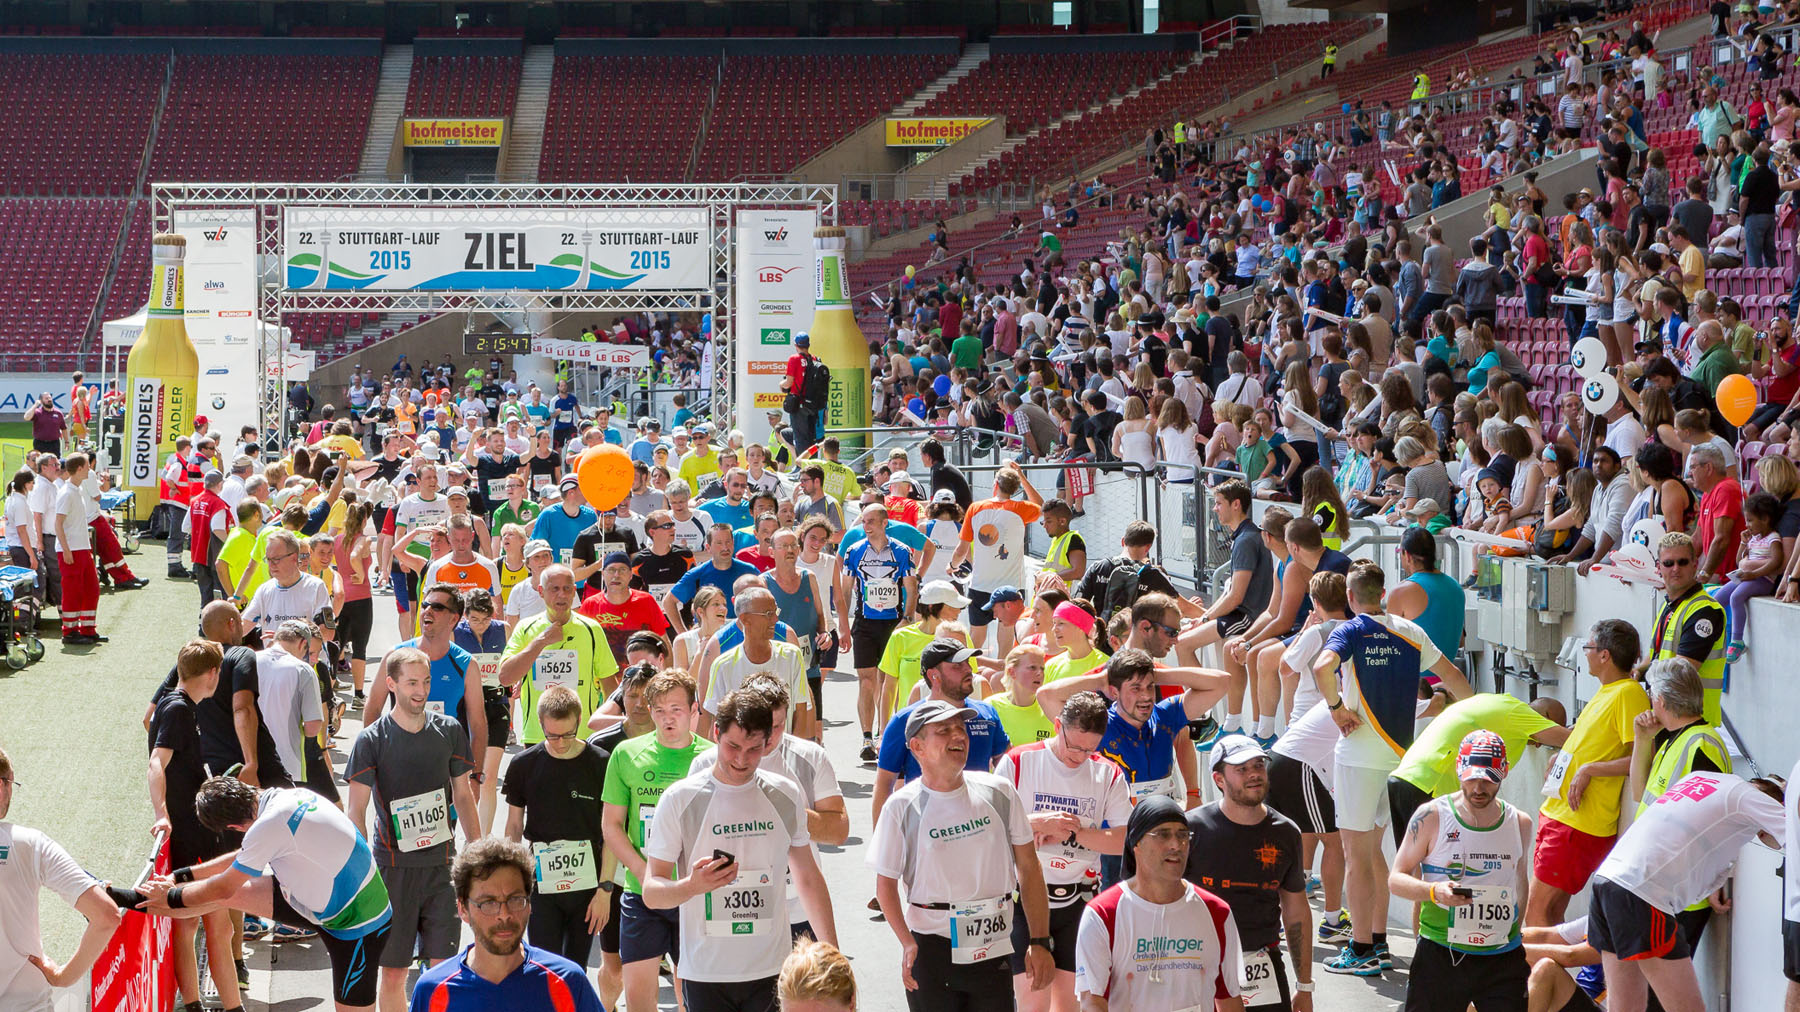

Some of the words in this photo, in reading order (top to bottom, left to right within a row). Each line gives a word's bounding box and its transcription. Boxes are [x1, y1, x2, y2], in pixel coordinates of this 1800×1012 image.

[411, 122, 498, 138] hofmeister
[299, 232, 316, 244] 22.
[339, 232, 440, 245] STUTTGART-LAUF
[561, 233, 578, 245] 22.
[599, 232, 699, 245] STUTTGART-LAUF
[464, 232, 535, 270] ZIEL
[370, 251, 411, 269] 2015
[630, 250, 671, 269] 2015
[760, 273, 783, 283] LBS
[204, 280, 225, 289] alwa
[766, 331, 786, 340] AOK
[476, 338, 530, 351] 2:15:47
[611, 355, 630, 363] LBS
[831, 381, 843, 426] FRESH
[170, 386, 184, 442] RADLER
[133, 383, 155, 480] GRÜNDEL'S
[869, 587, 897, 596] H10292
[1365, 645, 1378, 655] Auf
[541, 661, 572, 673] H5625
[1365, 657, 1388, 666] Team!
[1035, 794, 1079, 807] BOTTWARTAL
[402, 805, 445, 829] H11605
[419, 824, 437, 834] Michael
[416, 839, 431, 848] LBS
[548, 852, 586, 872] H5967
[1050, 860, 1066, 870] LBS
[1483, 861, 1502, 870] 2015
[556, 883, 571, 891] LBS
[1459, 903, 1511, 921] H11503
[966, 915, 1007, 936] H7368
[1468, 936, 1485, 945] LBS
[973, 951, 987, 960] LBS
[1136, 963, 1149, 972] Das
[1245, 963, 1270, 982] 825
